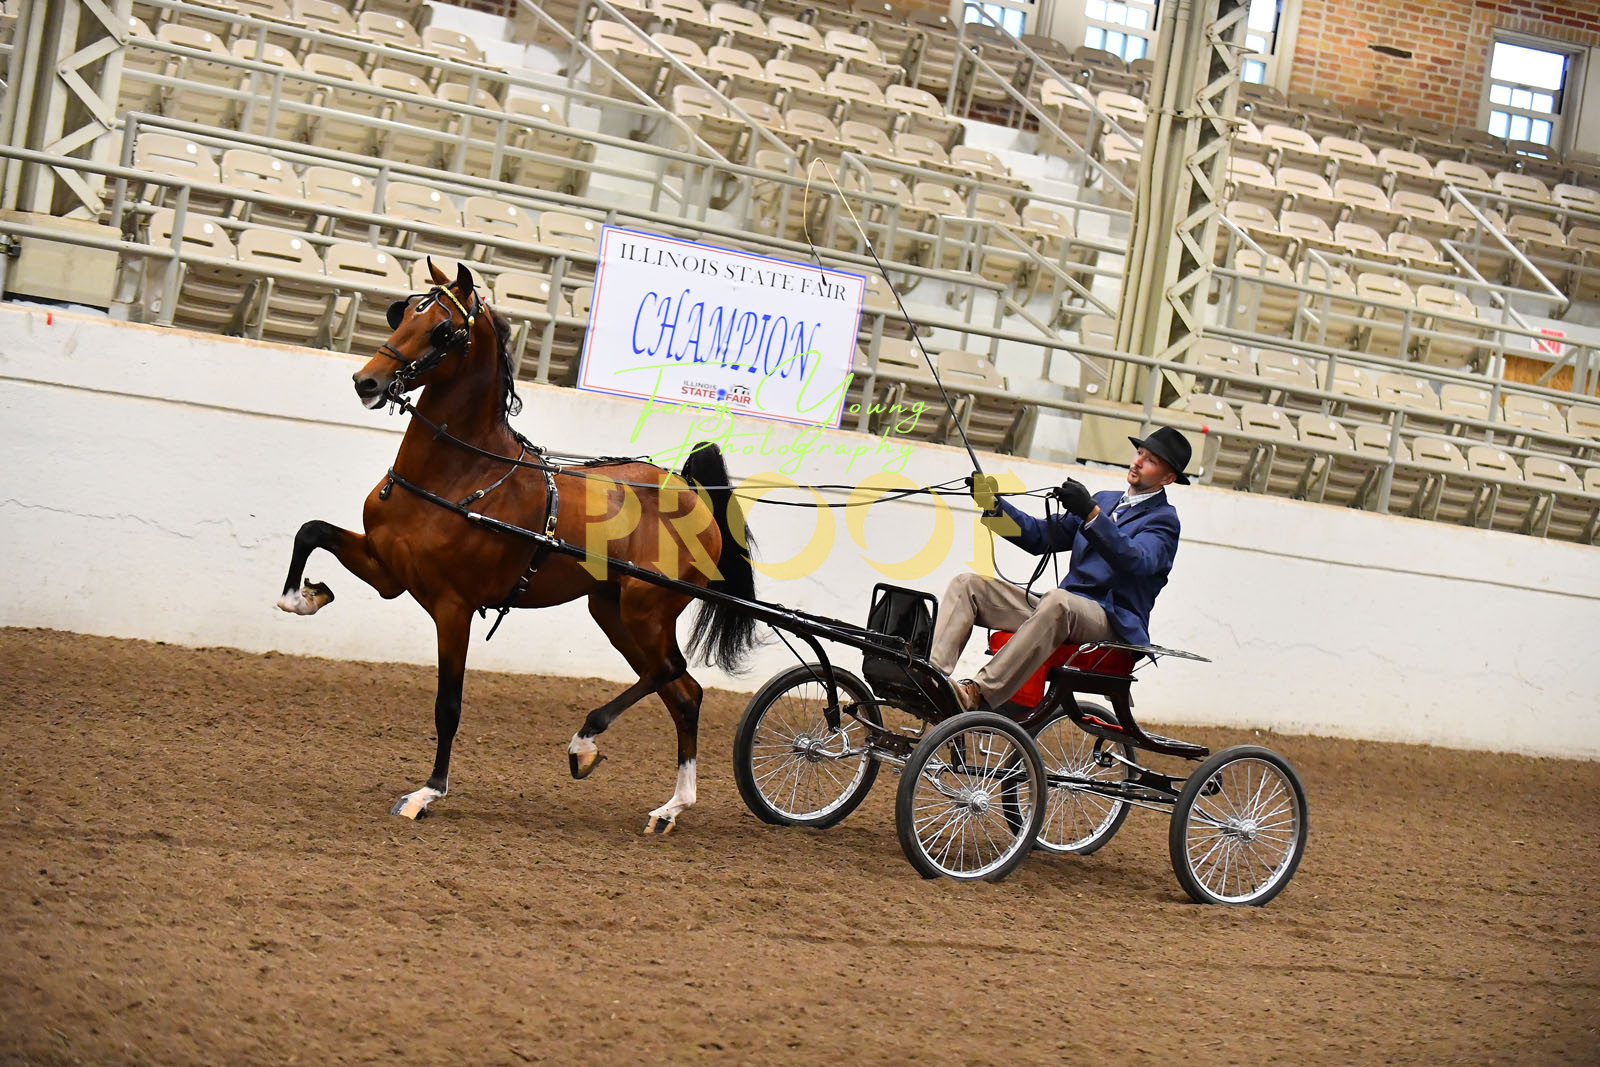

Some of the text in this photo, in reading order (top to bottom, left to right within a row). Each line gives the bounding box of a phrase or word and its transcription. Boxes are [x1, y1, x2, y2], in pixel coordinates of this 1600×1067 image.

[620, 243, 847, 301] ILLINOIS STATE FAIR
[632, 289, 821, 381] CHAMPION
[681, 386, 716, 399] STATE
[725, 393, 751, 405] FAIR
[683, 380, 718, 391] ILLINOIS
